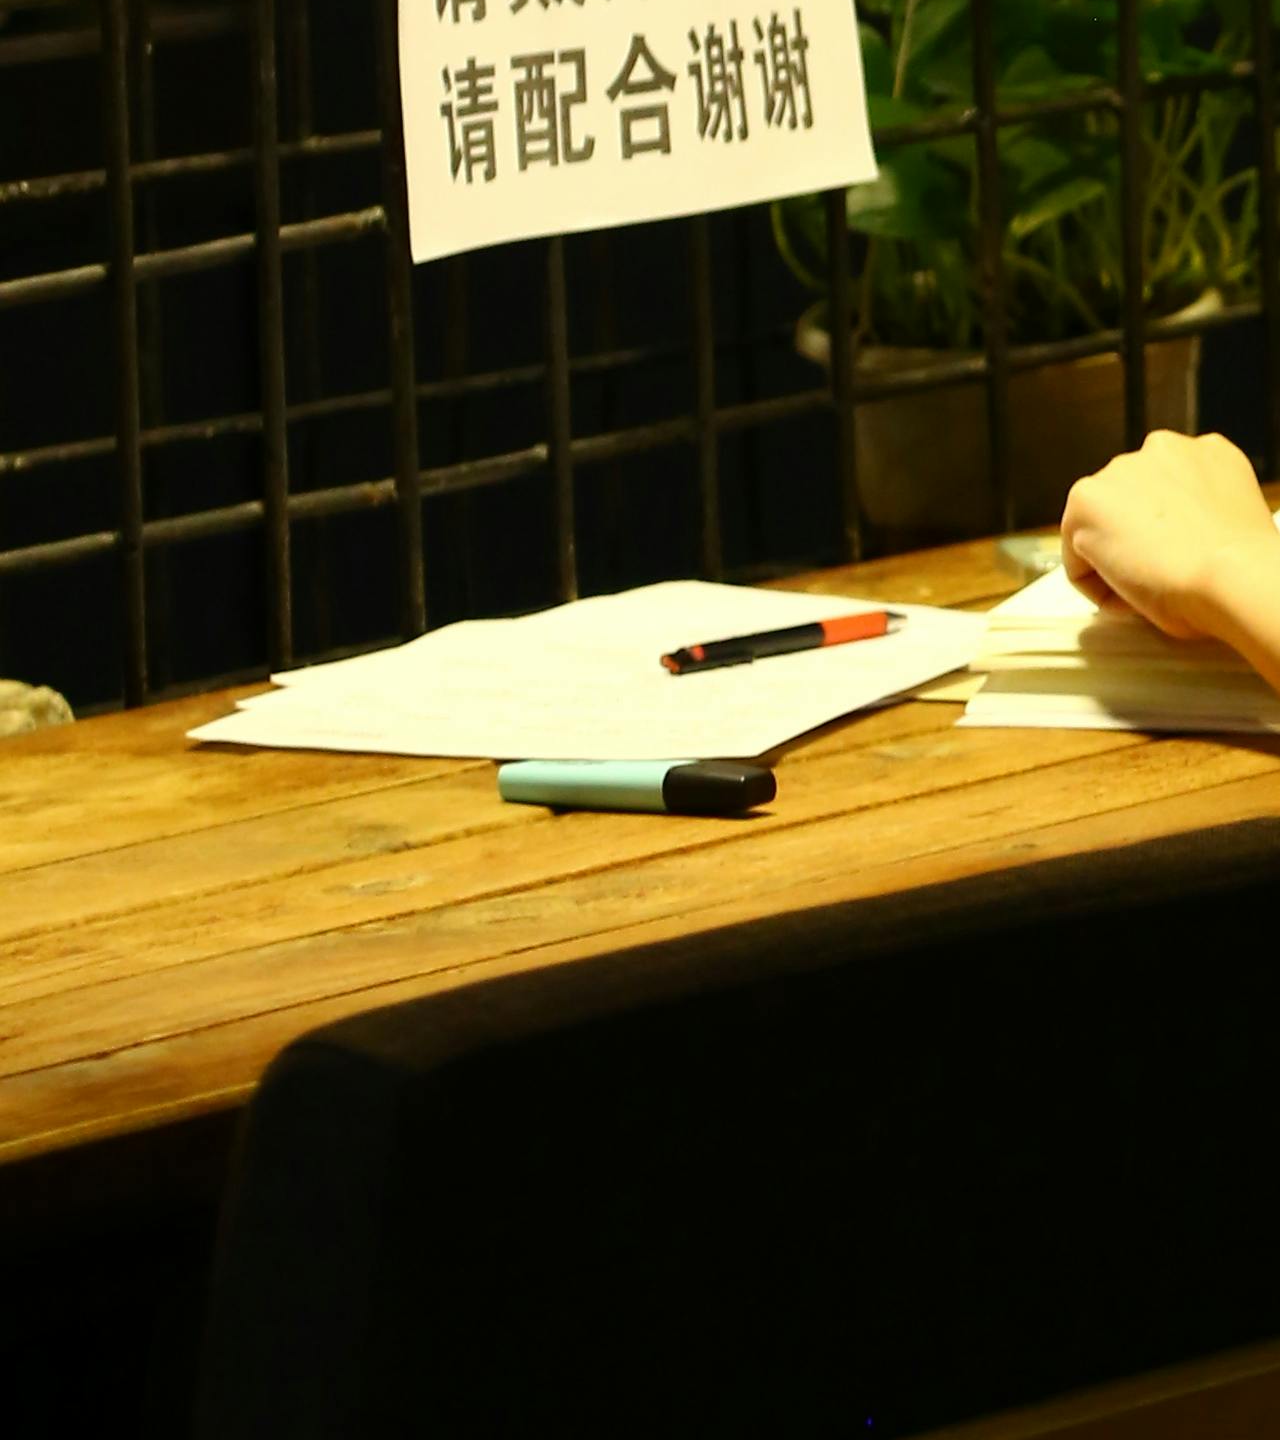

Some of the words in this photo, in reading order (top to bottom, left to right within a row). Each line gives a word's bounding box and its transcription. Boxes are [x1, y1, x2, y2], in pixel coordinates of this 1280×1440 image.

[440, 8, 815, 185] 请配合谢谢
